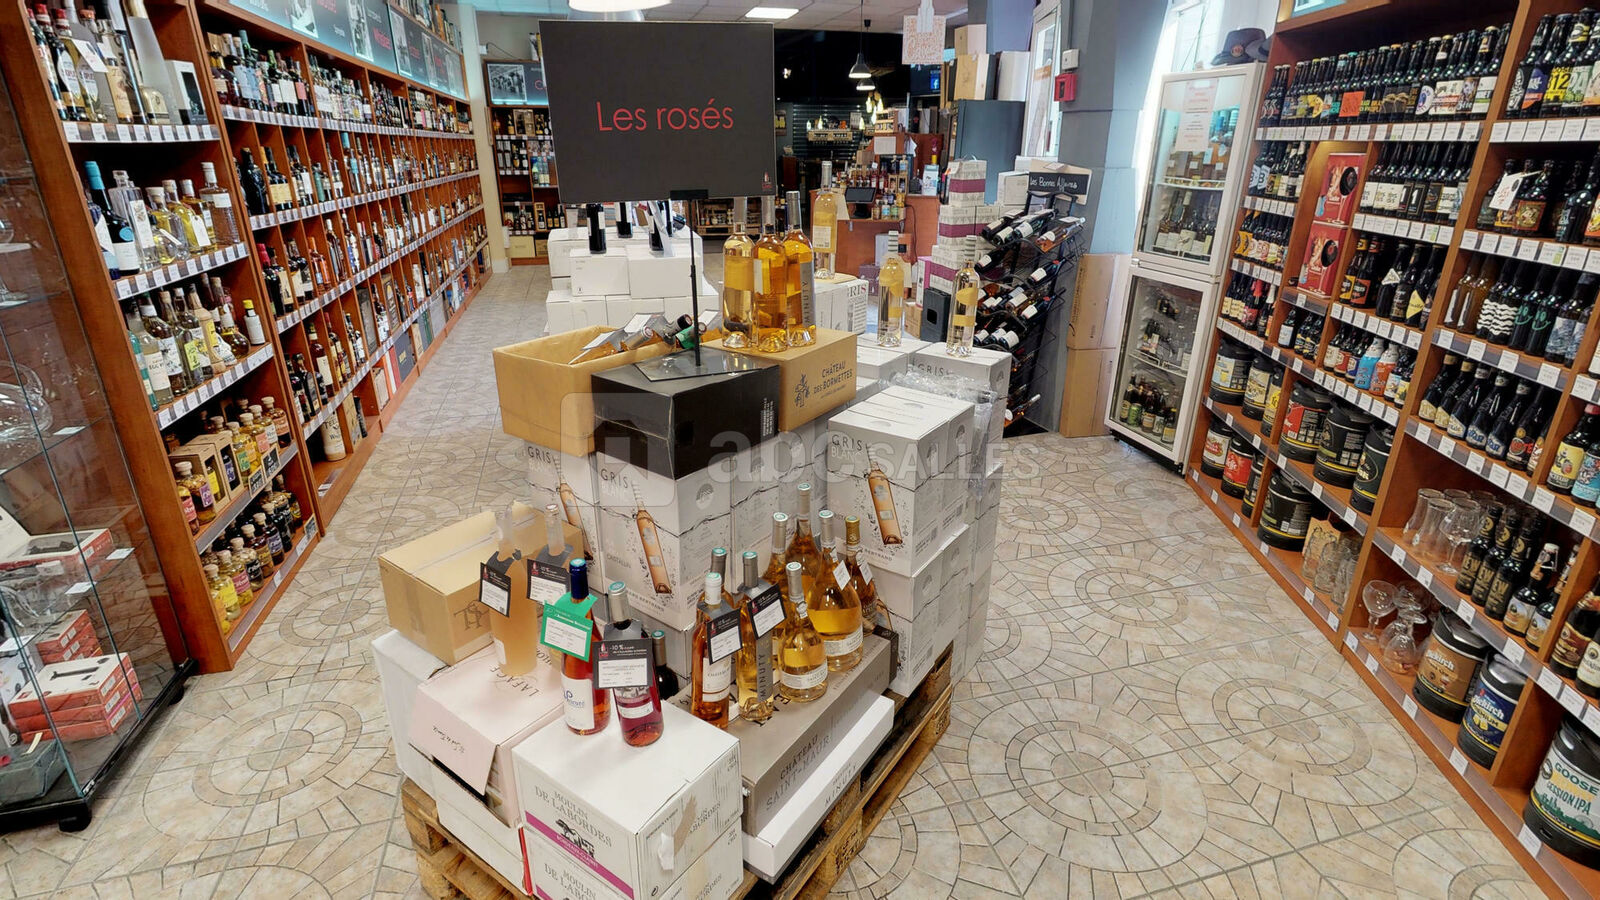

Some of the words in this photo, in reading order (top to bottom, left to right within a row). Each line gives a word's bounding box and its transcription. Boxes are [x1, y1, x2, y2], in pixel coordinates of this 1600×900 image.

[596, 101, 647, 132] Les
[656, 98, 734, 130] rosés
[813, 384, 822, 394] DES
[823, 368, 853, 390] BORMETTES
[821, 360, 846, 378] CHÂTEAU
[527, 446, 552, 464] GRIS
[831, 434, 862, 452] GRIS
[600, 468, 629, 489] GRIS
[758, 653, 767, 697] MINUTY
[765, 734, 832, 811] SAINT-MAUR
[1554, 762, 1600, 796] GOOSE
[554, 790, 589, 820] MOULIN
[1547, 780, 1575, 806] SESSION
[1573, 795, 1592, 816] IPA
[534, 785, 549, 802] DE
[552, 797, 613, 848] LABORDES
[544, 862, 558, 881] DE
[563, 869, 597, 897] MOULIN
